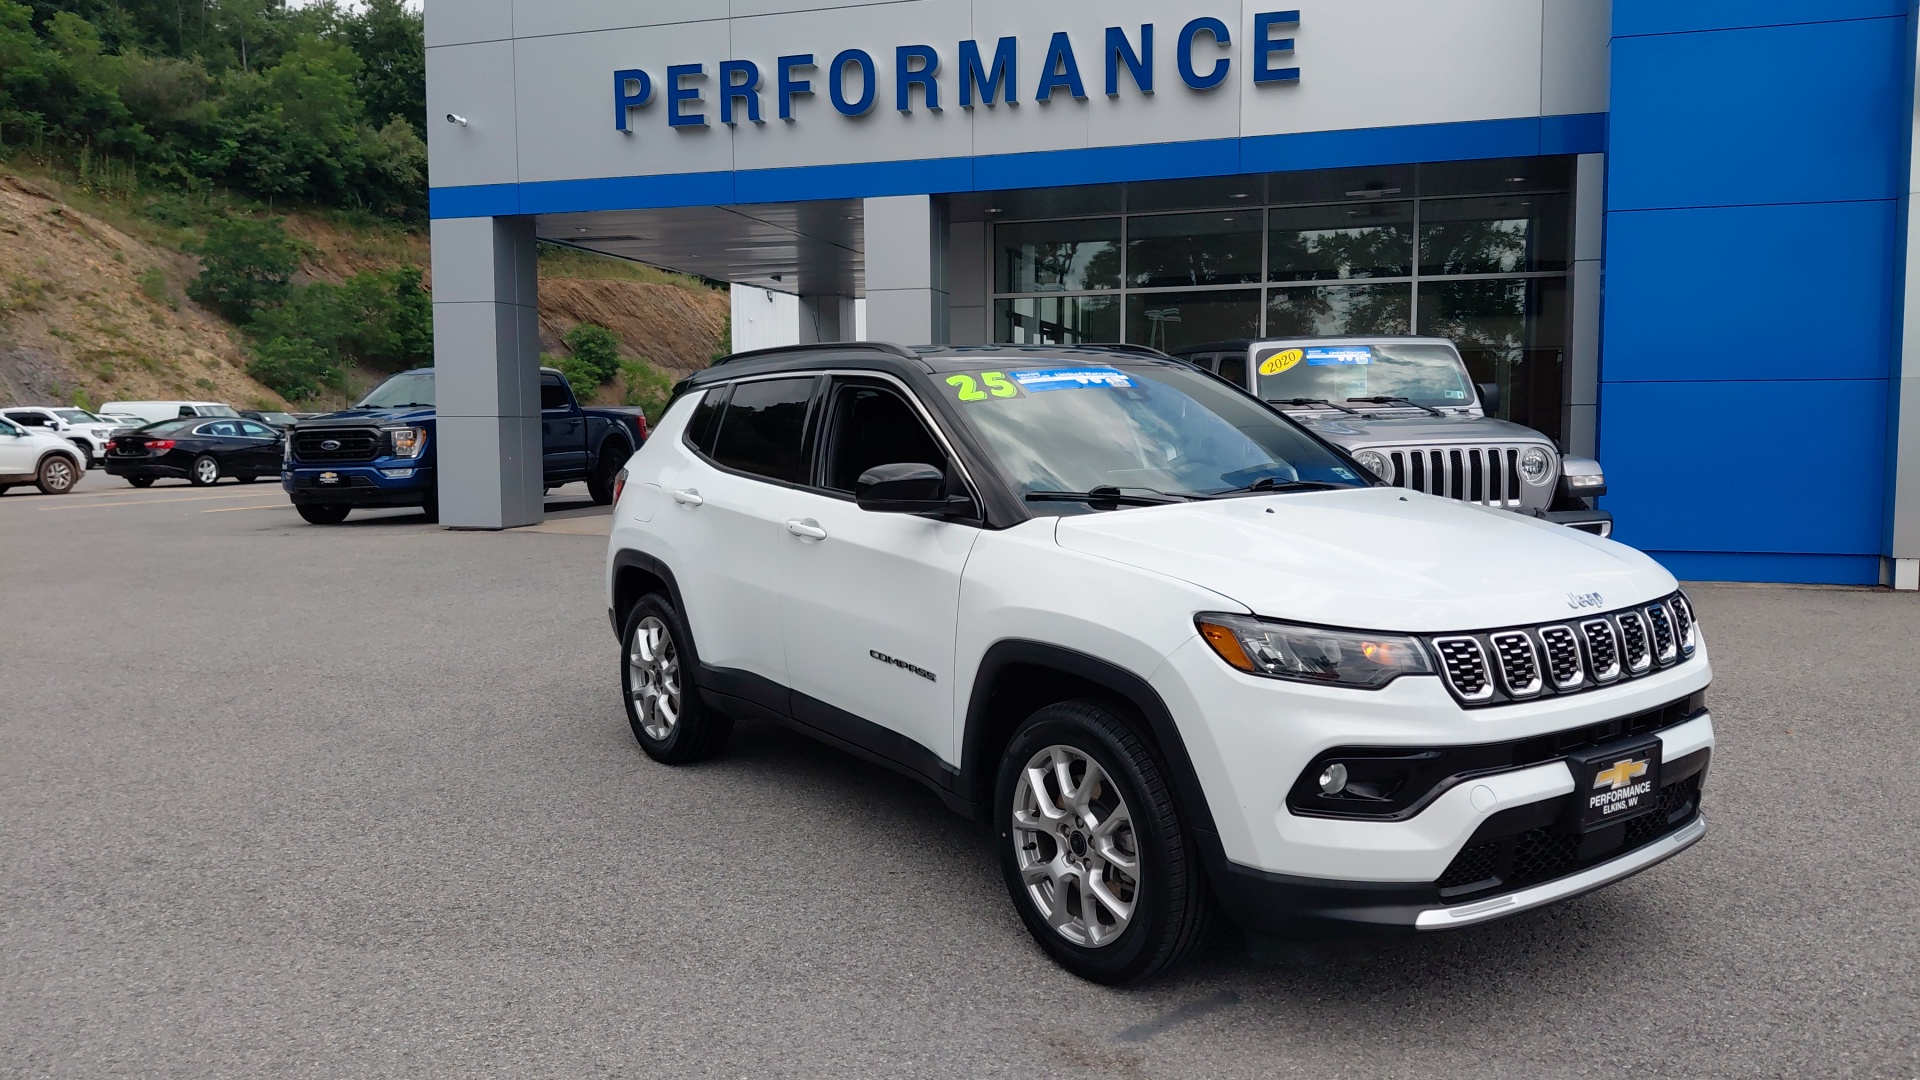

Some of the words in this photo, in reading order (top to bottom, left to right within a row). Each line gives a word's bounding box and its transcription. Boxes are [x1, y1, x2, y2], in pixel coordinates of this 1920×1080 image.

[613, 9, 1301, 132] PERFORMANCE
[1267, 352, 1296, 374] 2020
[945, 371, 1018, 401] 25
[1566, 591, 1604, 609] Jeep
[869, 649, 937, 683] COMPASS
[1589, 780, 1651, 809] PERFORMANCE
[1603, 800, 1628, 815] ELKINS,
[1628, 796, 1639, 808] WV
